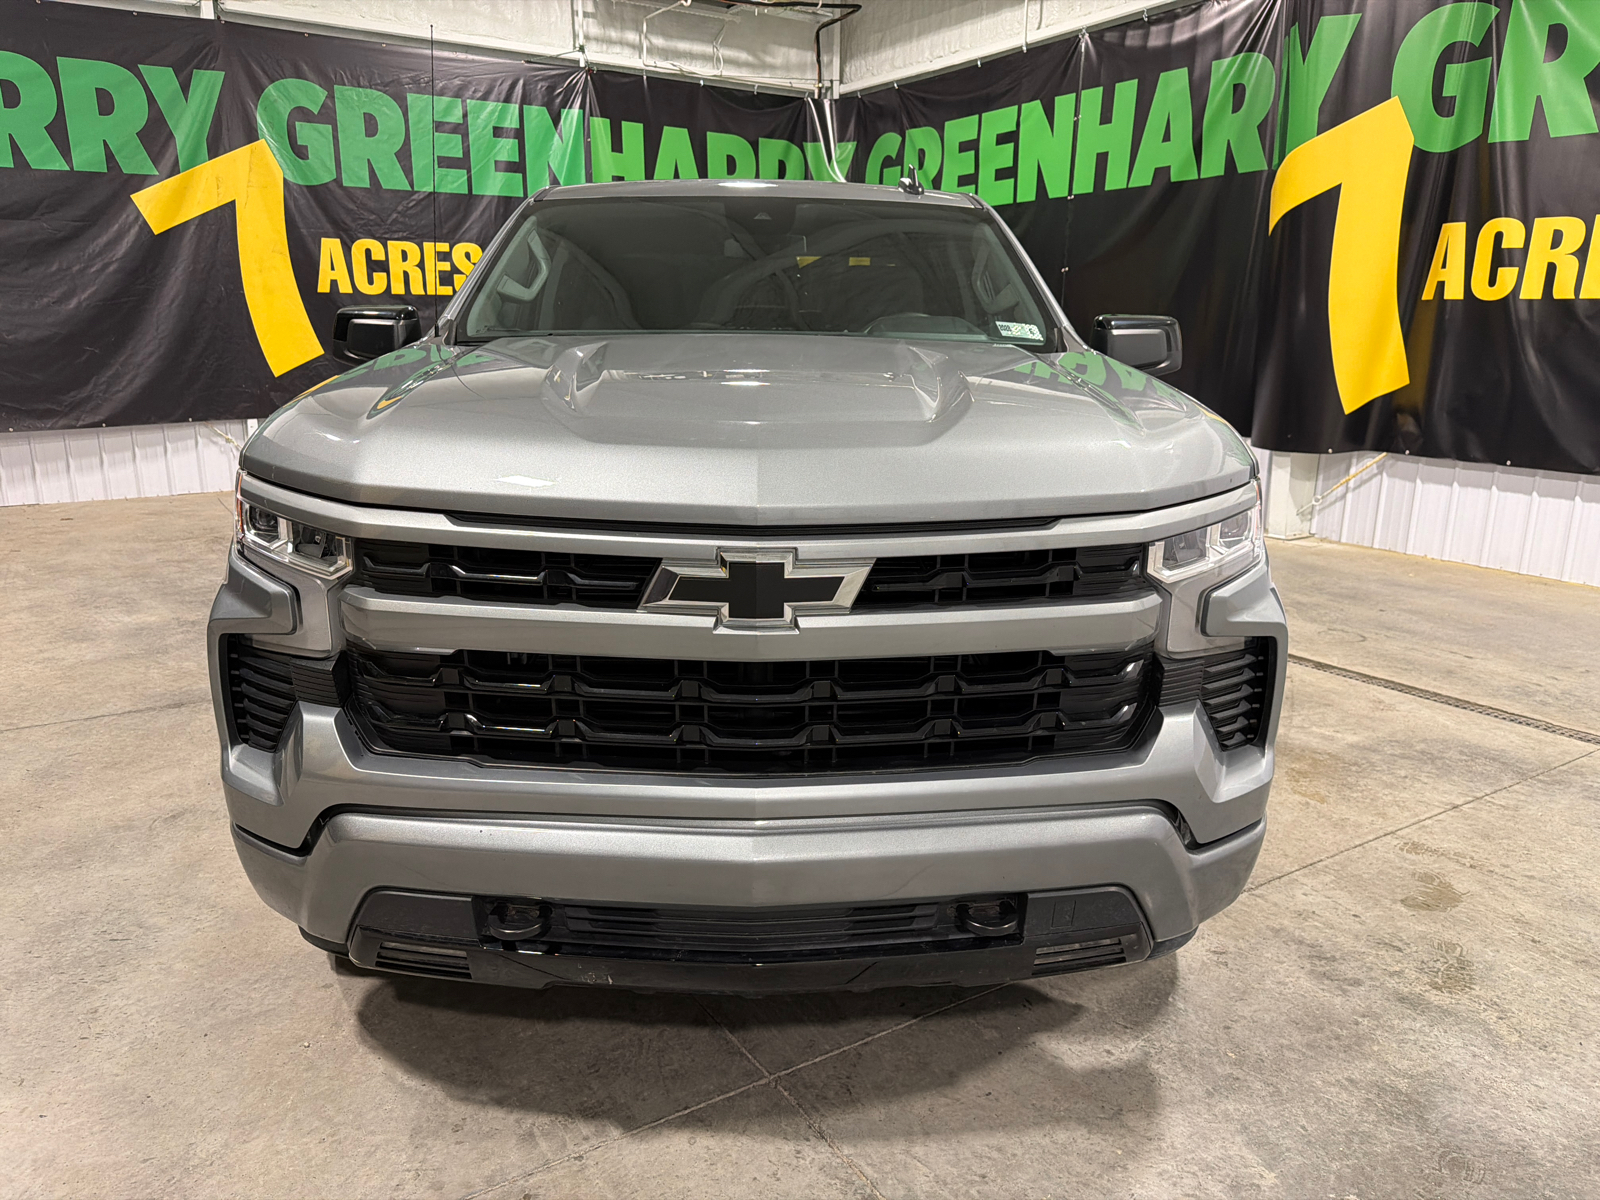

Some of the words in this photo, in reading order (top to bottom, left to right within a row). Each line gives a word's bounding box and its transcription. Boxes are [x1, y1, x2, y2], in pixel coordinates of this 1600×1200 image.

[257, 78, 587, 198] GREEN
[865, 92, 1077, 207] GREEN
[130, 138, 325, 377] 7
[317, 237, 483, 296] ACRES
[1269, 95, 1414, 415] 7
